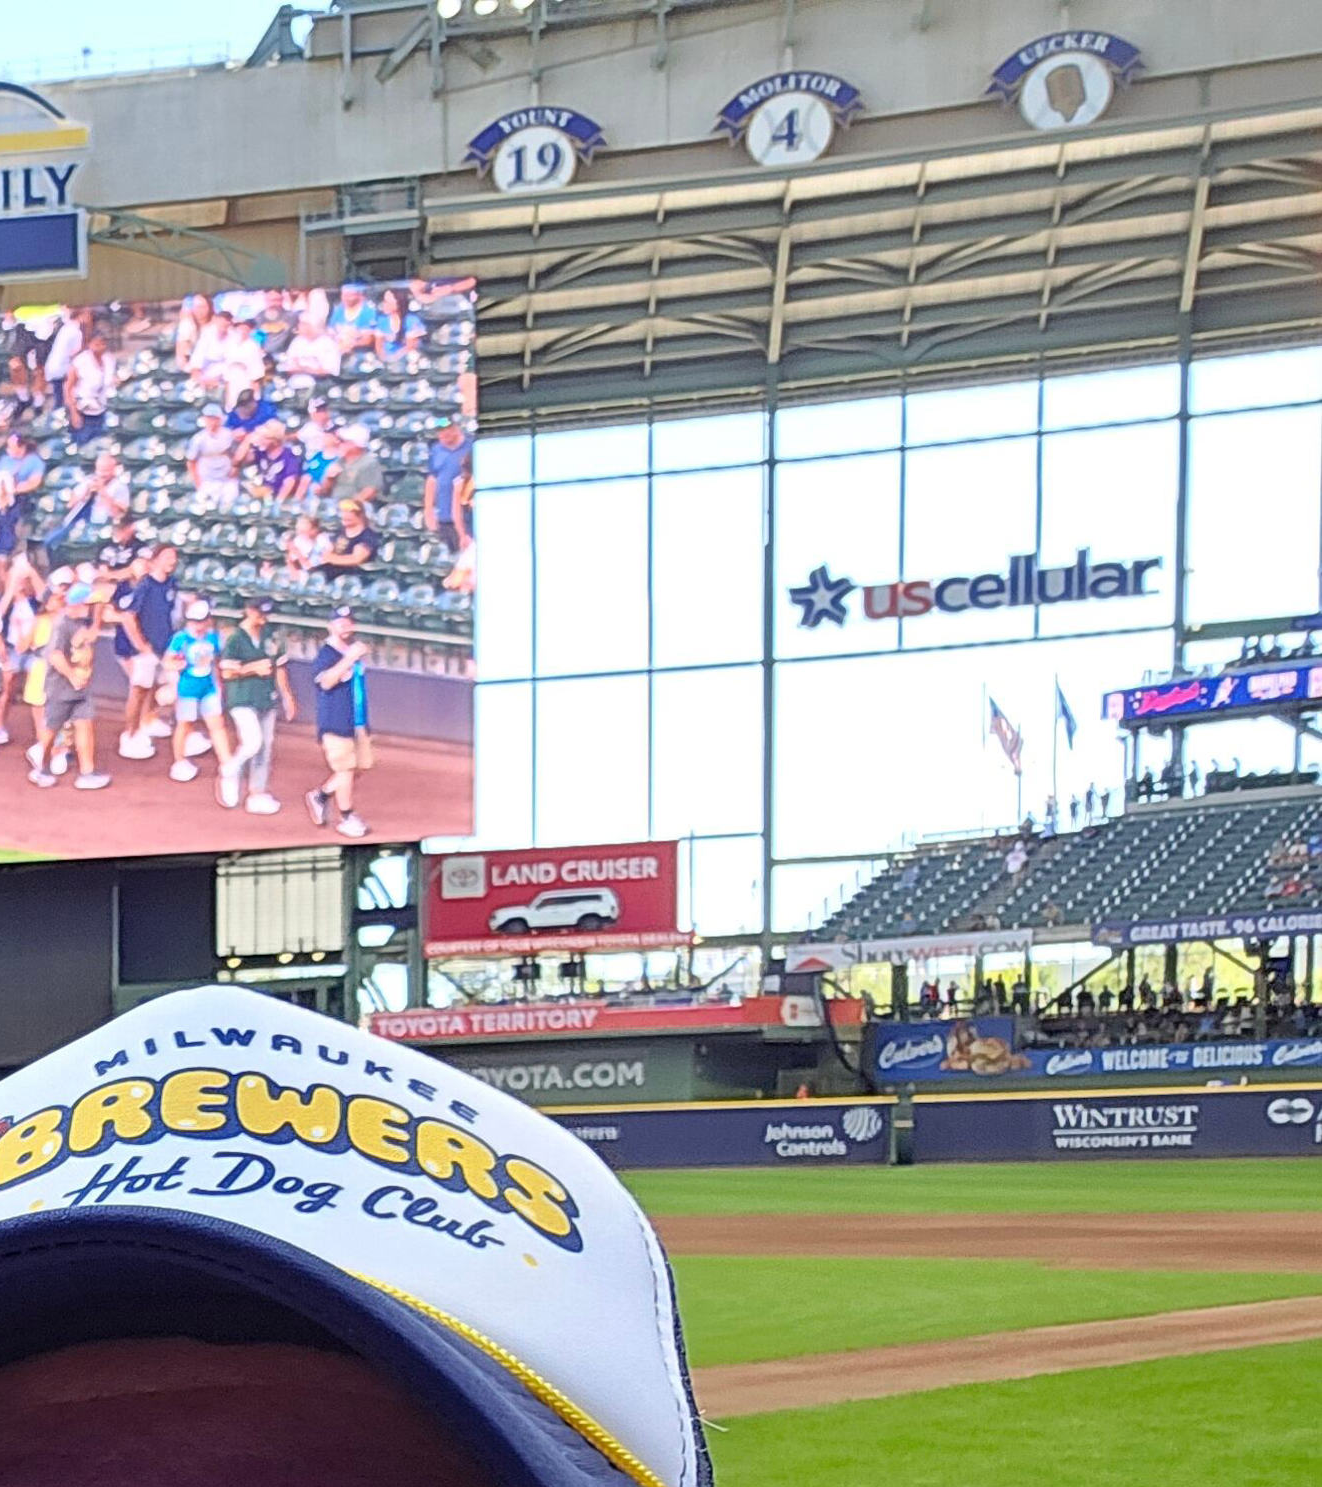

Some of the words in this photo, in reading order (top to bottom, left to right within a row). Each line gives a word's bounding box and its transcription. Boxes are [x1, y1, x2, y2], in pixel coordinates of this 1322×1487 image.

[1019, 34, 1109, 65] UECKER
[738, 73, 841, 109] MOLITOR
[499, 111, 573, 134] YOUNT
[771, 107, 803, 153] 4
[507, 141, 563, 187] 19
[863, 547, 1161, 619] uscellular
[491, 861, 556, 886] LAND
[560, 857, 659, 883] CRUISER
[1130, 923, 1178, 942] GREAT
[1181, 920, 1231, 938] TASTE.
[1233, 919, 1255, 934] 96
[1258, 913, 1322, 933] CALORIE
[377, 1015, 465, 1038] TOYOTA
[470, 1008, 599, 1033] TERRITORY
[1103, 1049, 1169, 1071] WELCOME
[1192, 1047, 1264, 1068] DELICIOUS
[93, 1027, 479, 1125] MILWAUKEE
[471, 1061, 645, 1091] OYOTA.COM
[1053, 1104, 1199, 1129] WINTRUST
[765, 1123, 834, 1142] Johnson
[776, 1138, 847, 1157] Controls
[1055, 1134, 1148, 1150] WISCONSIN'S
[1151, 1133, 1193, 1147] BANK
[63, 1155, 189, 1208] Hot
[189, 1151, 345, 1214] Dog
[360, 1185, 506, 1252] Club
